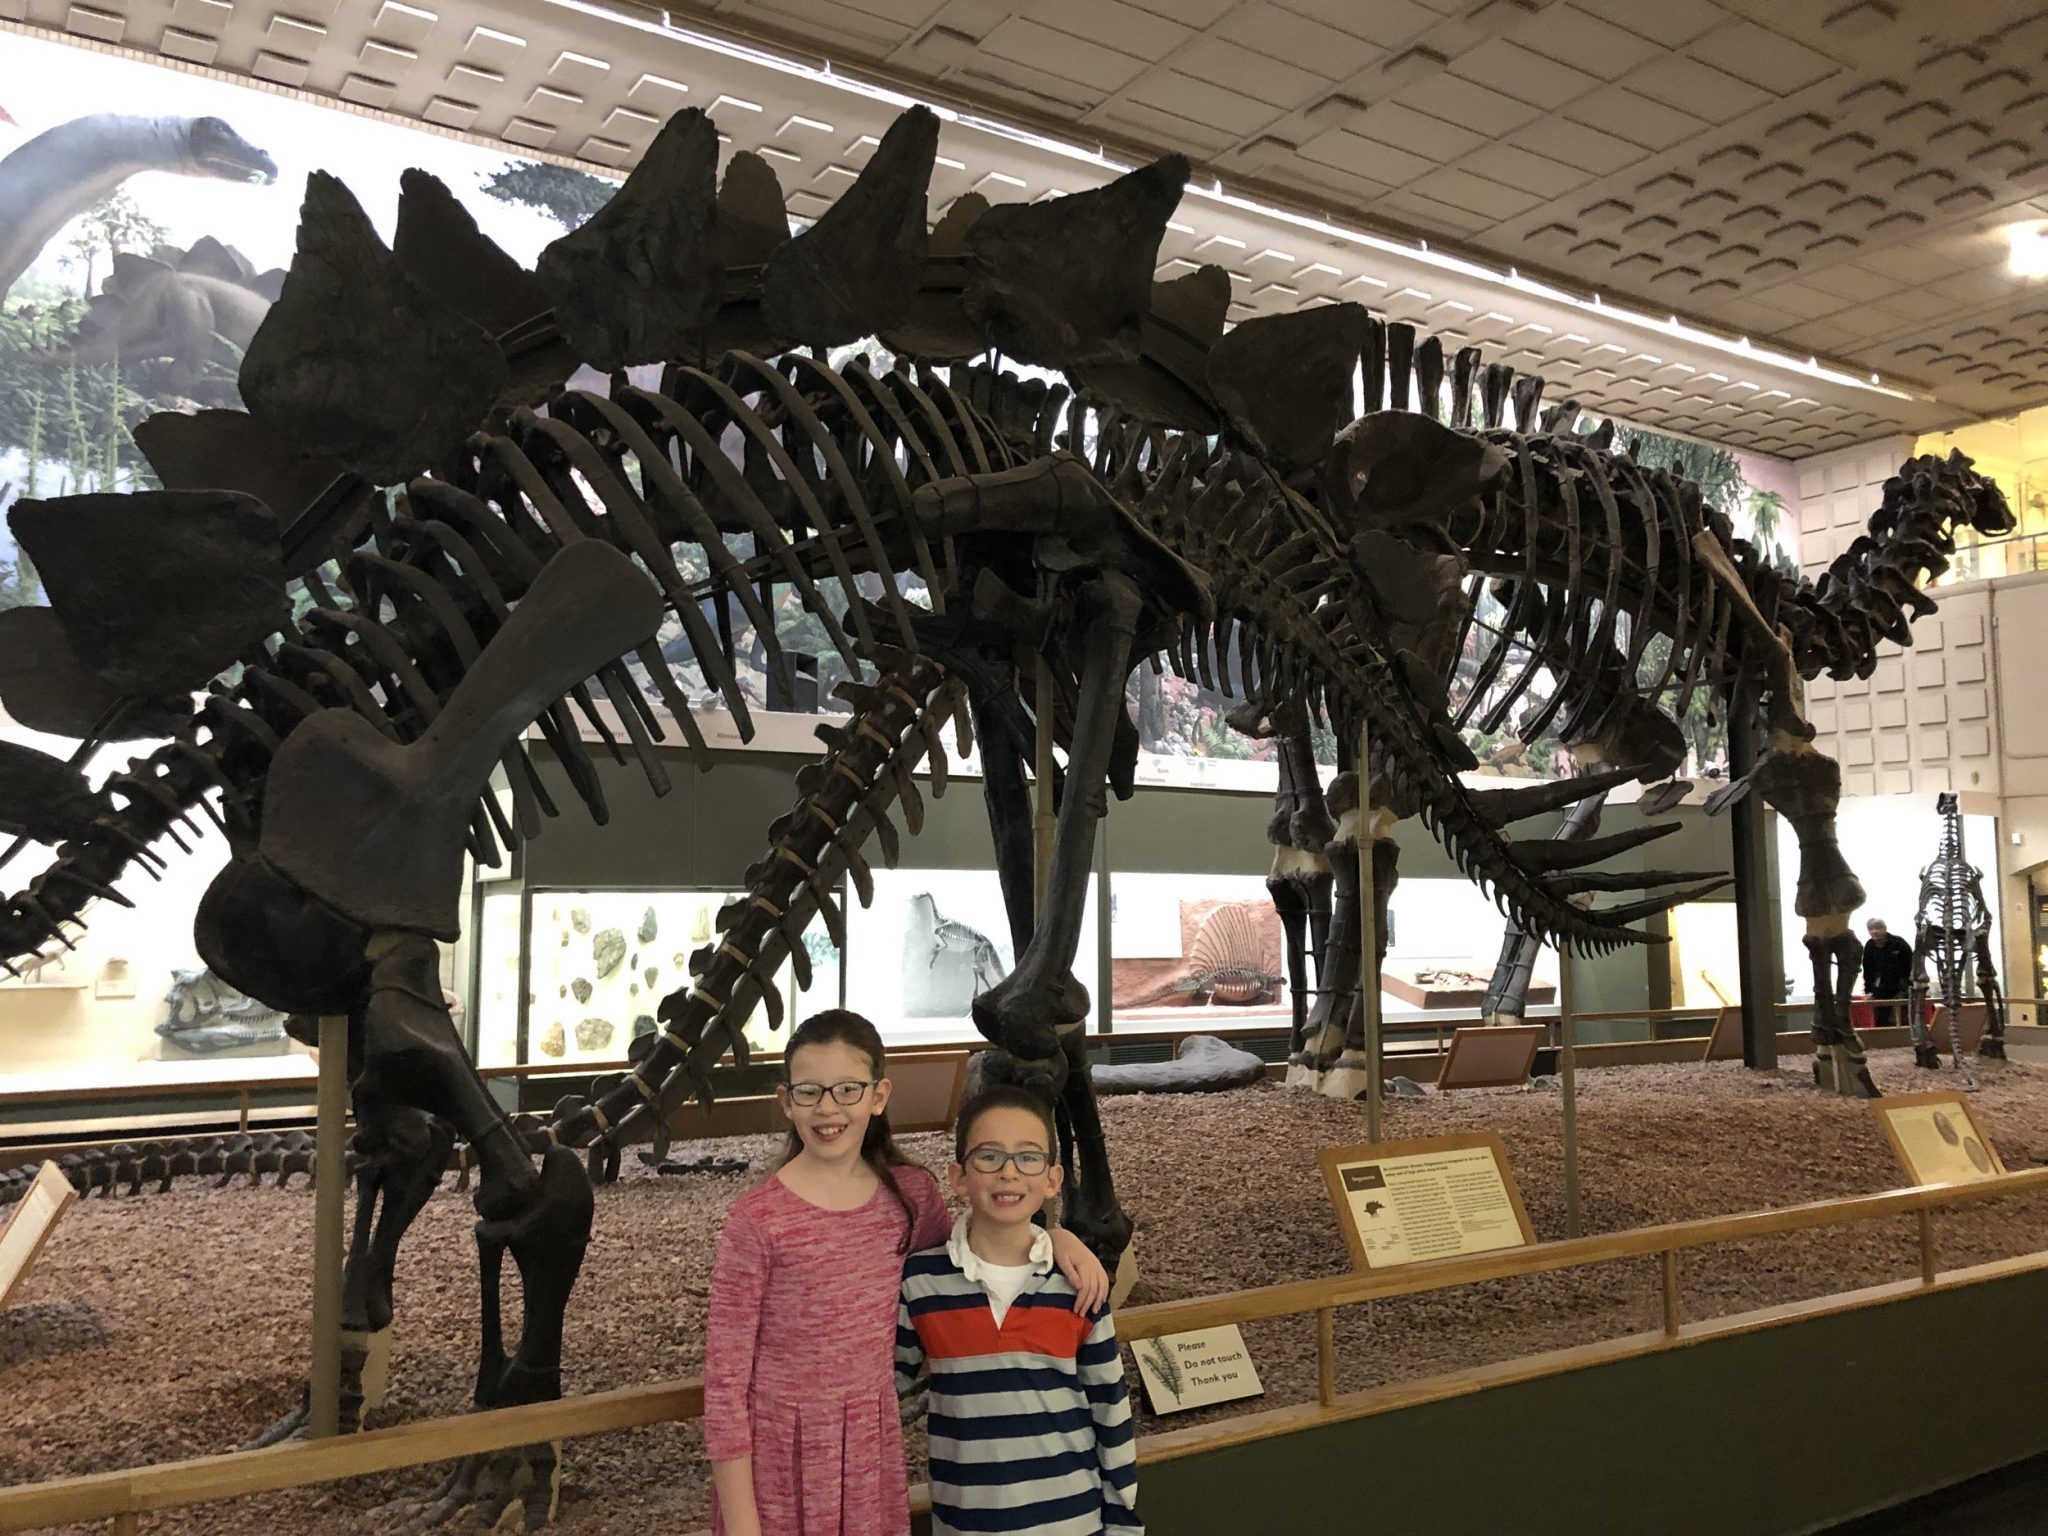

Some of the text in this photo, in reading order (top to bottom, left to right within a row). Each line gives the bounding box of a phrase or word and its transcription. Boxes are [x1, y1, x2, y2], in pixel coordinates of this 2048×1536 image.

[1178, 1342, 1206, 1352] Please
[1184, 1352, 1242, 1370] Do not touch
[1191, 1372, 1238, 1386] Thank you
